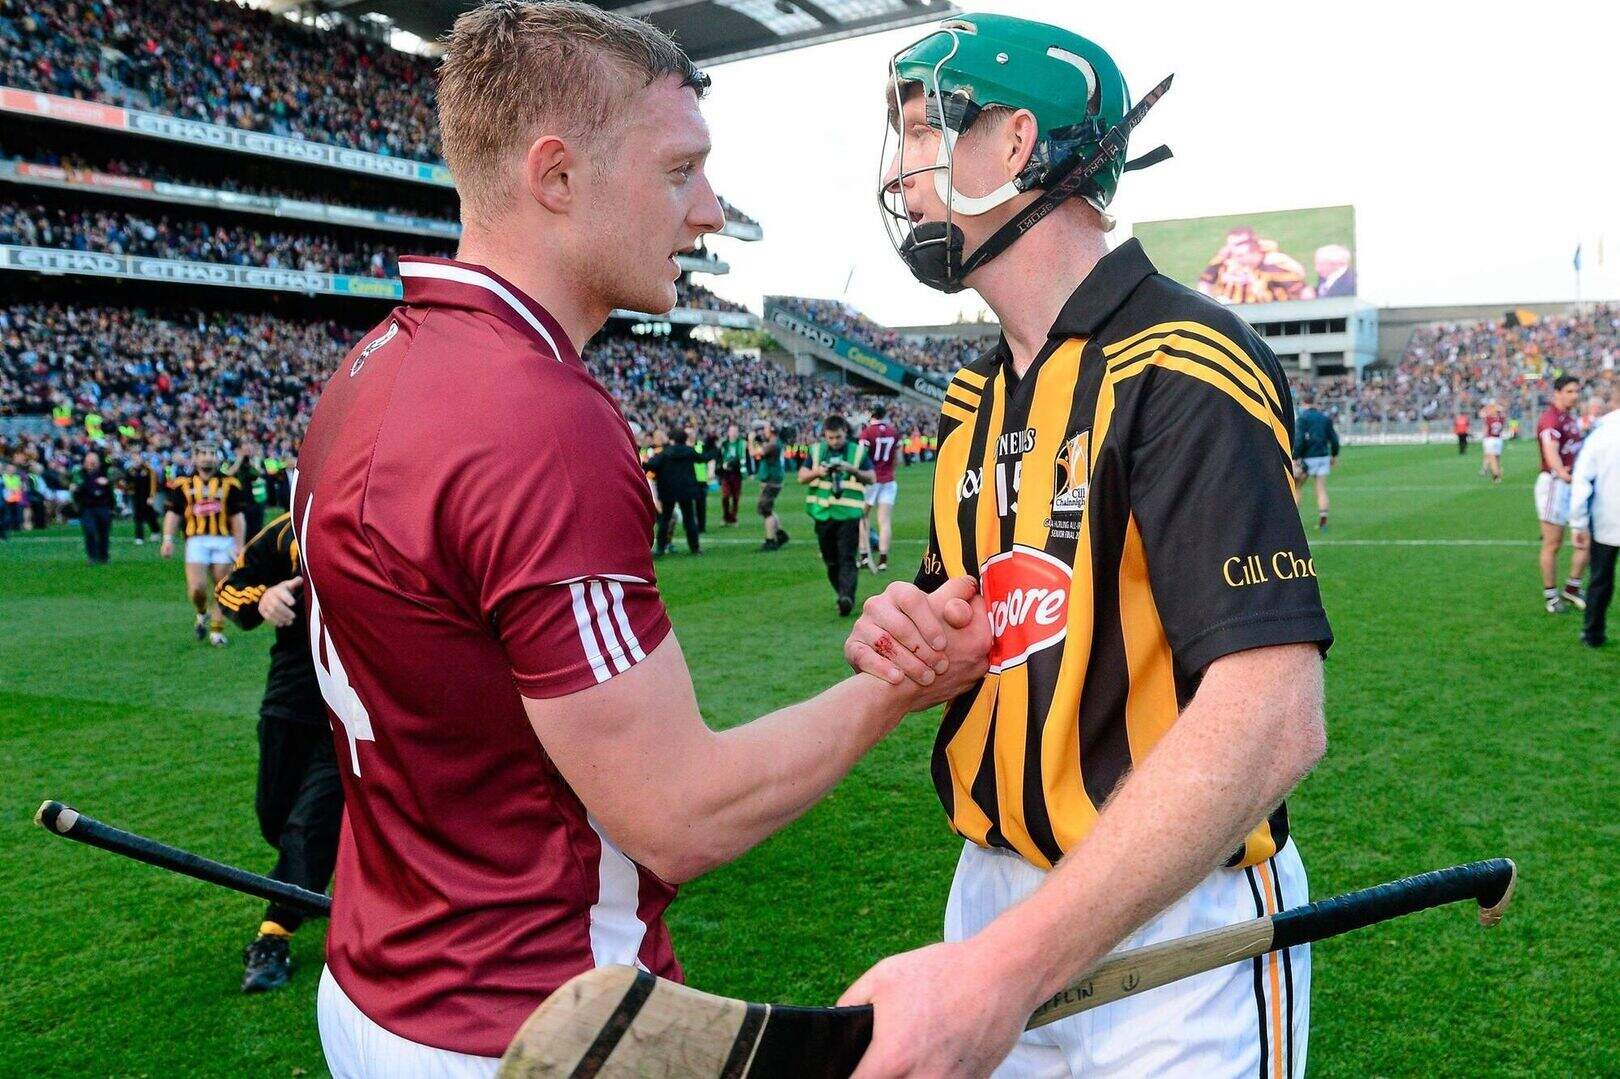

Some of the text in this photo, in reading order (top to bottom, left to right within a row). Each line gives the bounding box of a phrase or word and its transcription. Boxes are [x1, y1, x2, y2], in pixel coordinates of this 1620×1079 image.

[136, 114, 225, 144] ETIHAD
[1016, 201, 1054, 233] SPORT
[17, 250, 121, 273] ETIHAD
[140, 260, 228, 282] ETIHAD
[246, 269, 324, 291] ETIHAD
[773, 311, 836, 348] ETIHAD
[874, 436, 895, 461] 17
[1222, 554, 1269, 588] Cill
